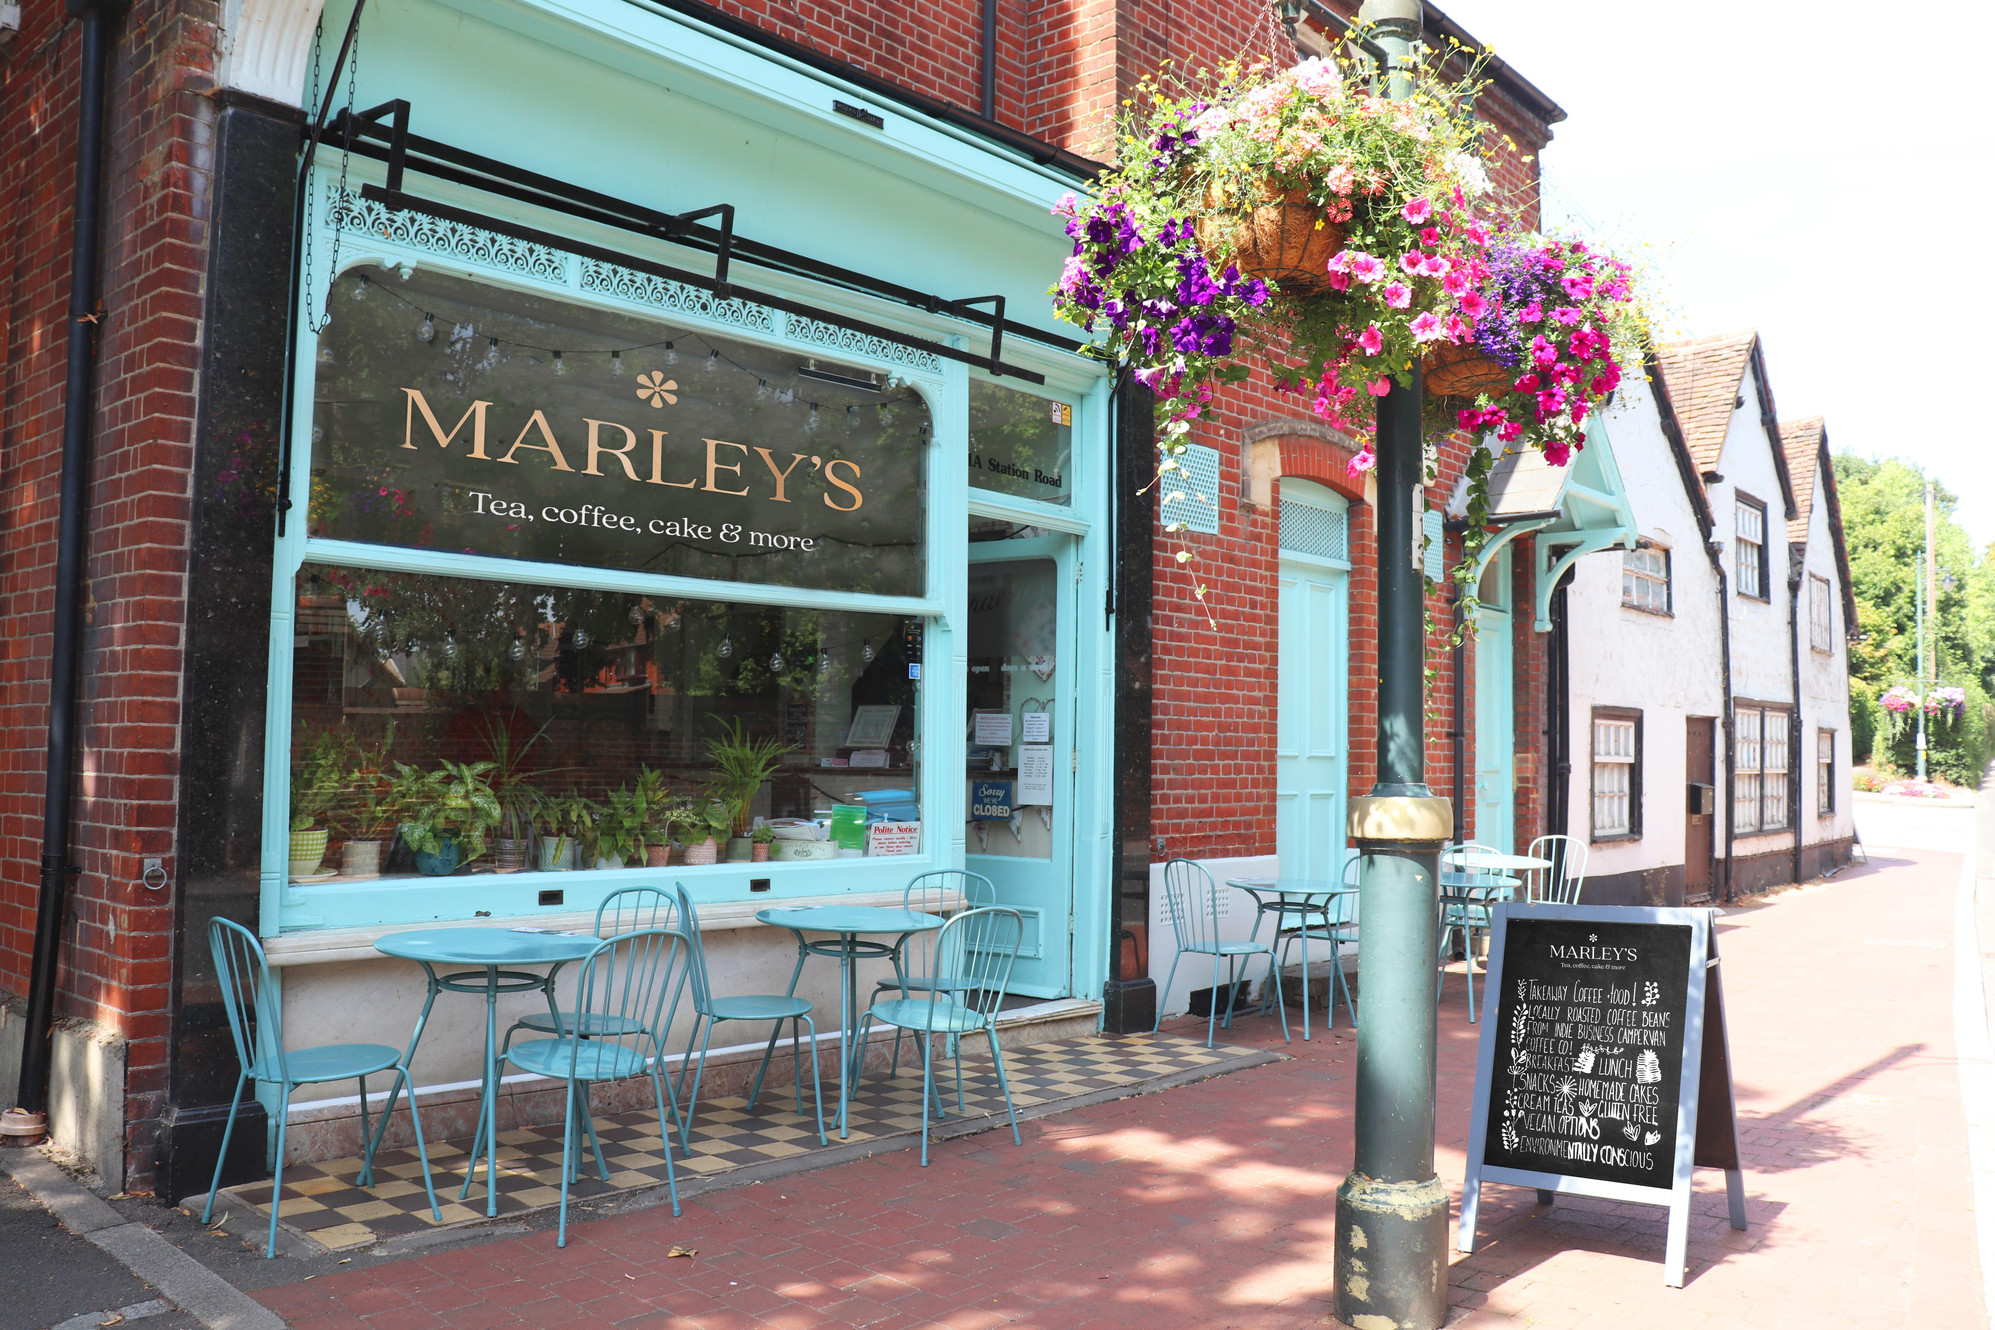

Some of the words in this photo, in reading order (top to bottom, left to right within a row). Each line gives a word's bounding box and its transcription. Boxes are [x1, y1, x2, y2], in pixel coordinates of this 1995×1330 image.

[400, 387, 864, 512] MARLEY'S
[988, 458, 1029, 481] Station
[1034, 469, 1062, 488] Road
[468, 491, 534, 522] Tea,
[541, 504, 641, 534] coffee,
[648, 517, 713, 541] cake
[718, 523, 743, 543] &
[748, 530, 815, 552] more
[978, 784, 1005, 800] Sorry
[973, 804, 1010, 817] CLOSED
[873, 825, 893, 834] Polite
[897, 825, 918, 833] Notice
[1550, 944, 1638, 962] MARLEY'S
[1528, 979, 1568, 1001] TAKEAWAY
[1574, 980, 1604, 1004] COFFEE
[1528, 1004, 1560, 1020] LOCALLY
[1567, 1006, 1601, 1024] ROASTED
[1606, 1008, 1638, 1026] COFFEE
[1642, 1010, 1670, 1028] BEANS
[1526, 1020, 1548, 1036] FROM
[1554, 1022, 1574, 1038] INDIE
[1578, 1024, 1614, 1042] BUSINESS
[1618, 1028, 1666, 1046] CAMPERVAN
[1526, 1036, 1555, 1054] COFFEE
[1558, 1040, 1573, 1056] CO!
[1526, 1054, 1577, 1072] BREAKFAST
[1599, 1058, 1632, 1078] LUNCH
[1518, 1072, 1556, 1094] SNACKS
[1578, 1078, 1626, 1102] HOMEMADE
[1629, 1084, 1660, 1105] CAKES
[1518, 1093, 1550, 1112] CREAM
[1554, 1096, 1574, 1116] TEAS
[1598, 1100, 1630, 1120] GLUTEN
[1632, 1104, 1658, 1126] FREE
[1524, 1114, 1556, 1133] VEGAN
[1558, 1115, 1600, 1140] OPTIONS
[1520, 1136, 1598, 1162] ENVIRONMENTALLY
[1600, 1145, 1654, 1170] CONSCIOUS
